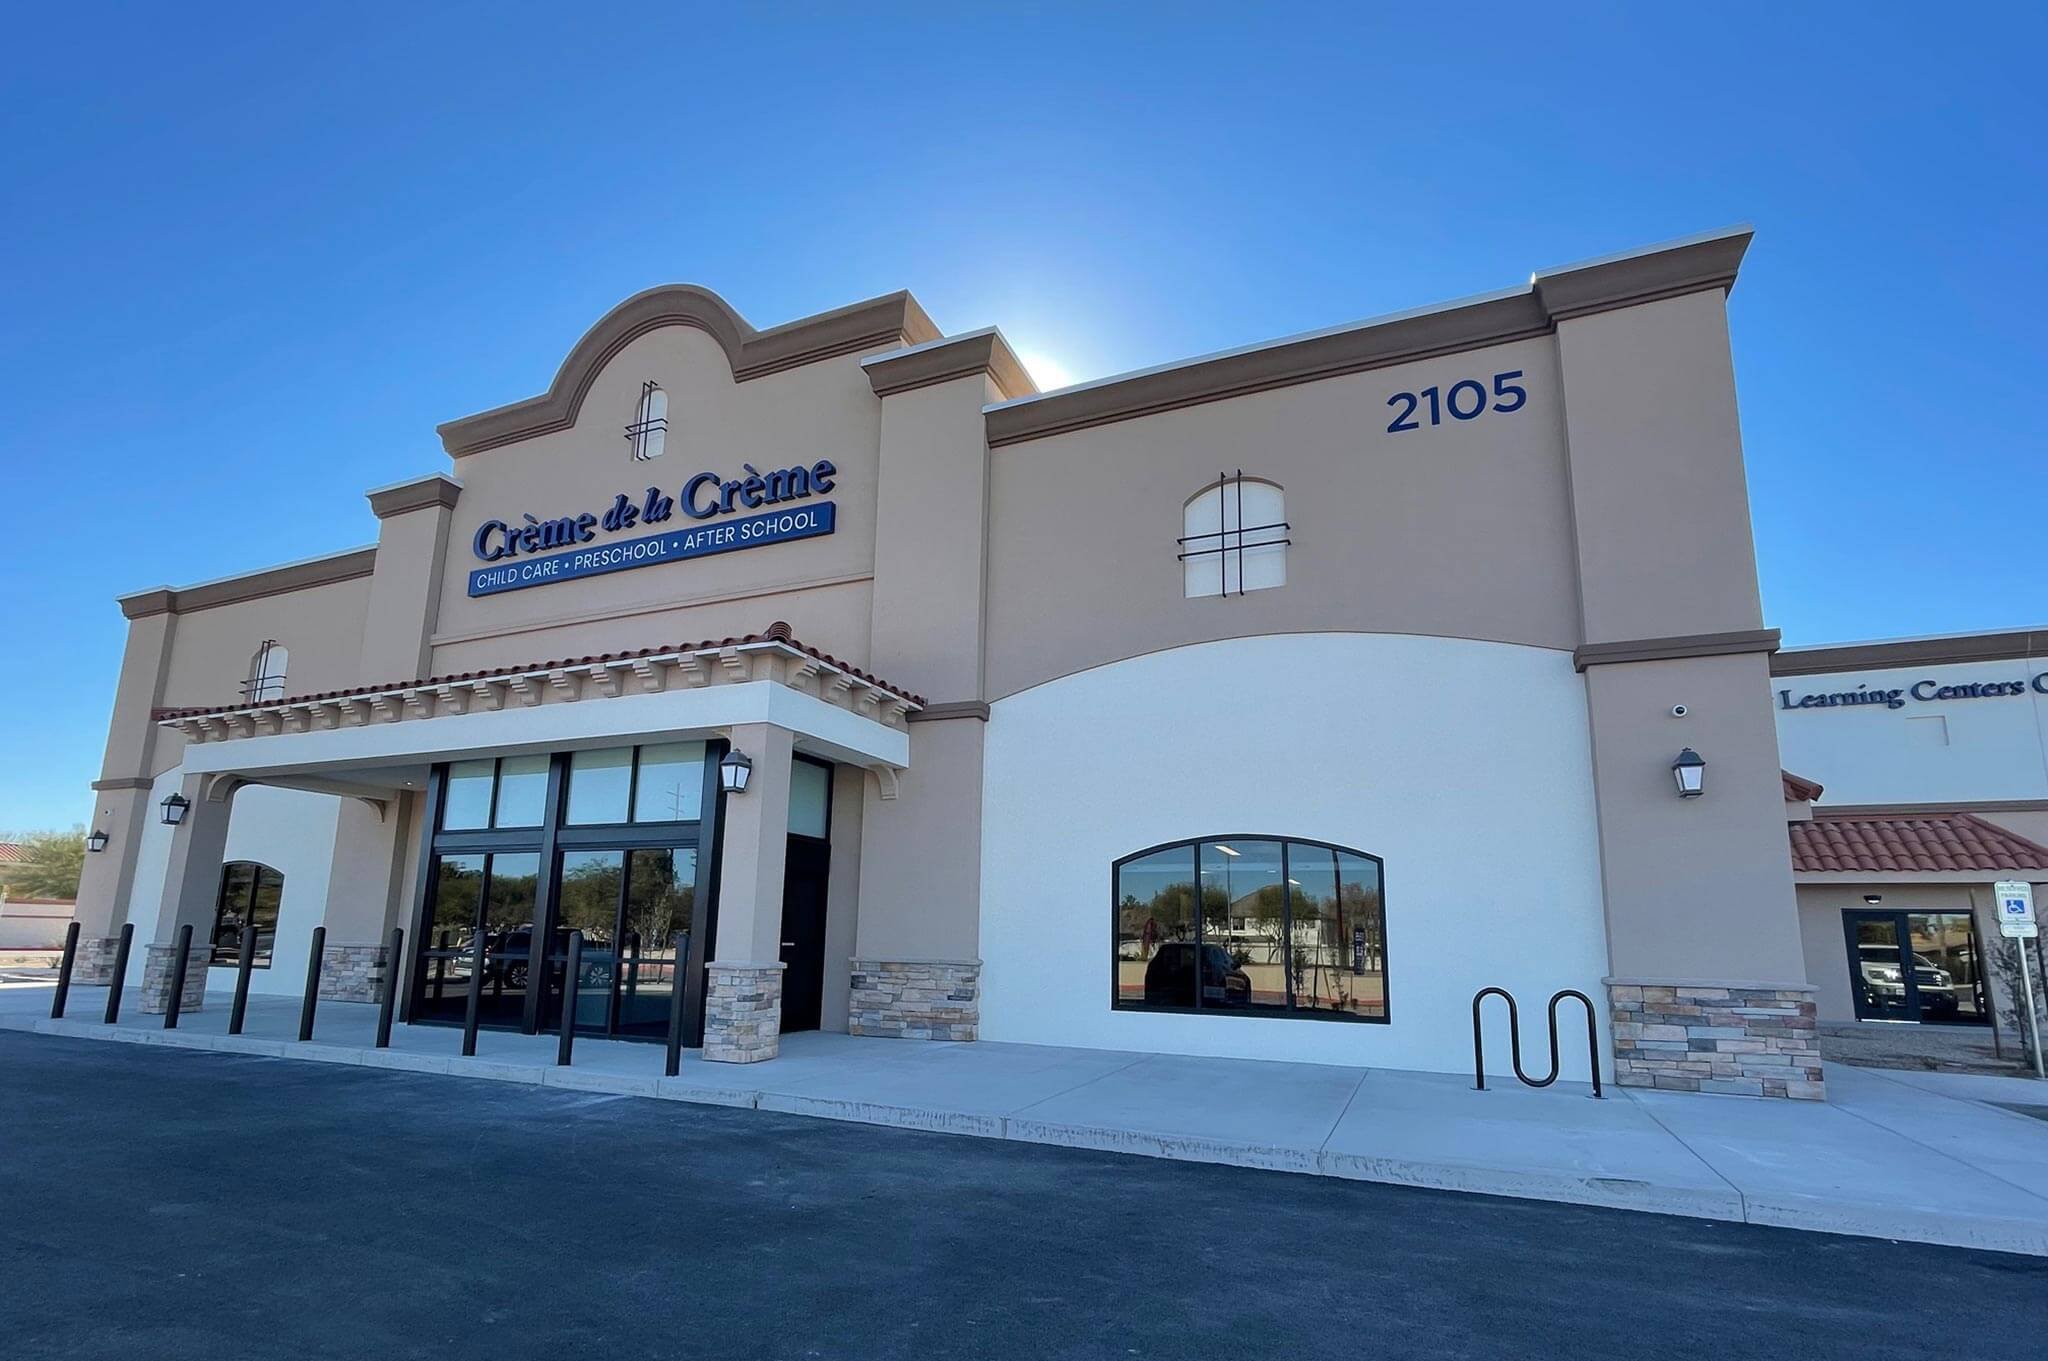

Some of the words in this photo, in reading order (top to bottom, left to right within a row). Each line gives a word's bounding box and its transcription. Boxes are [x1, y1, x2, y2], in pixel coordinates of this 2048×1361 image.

[1386, 370, 1527, 433] 2105
[474, 511, 597, 562] Crème
[601, 494, 640, 531] de
[640, 486, 674, 523] la
[680, 459, 836, 519] Crème
[476, 568, 518, 589] CHILD
[521, 560, 560, 582] CARE
[573, 540, 667, 570] PRESCHOOL
[683, 528, 735, 549] AFTER
[740, 511, 818, 540] SCHOOL
[1780, 684, 1906, 710] Learning
[1910, 680, 2025, 702] Centers
